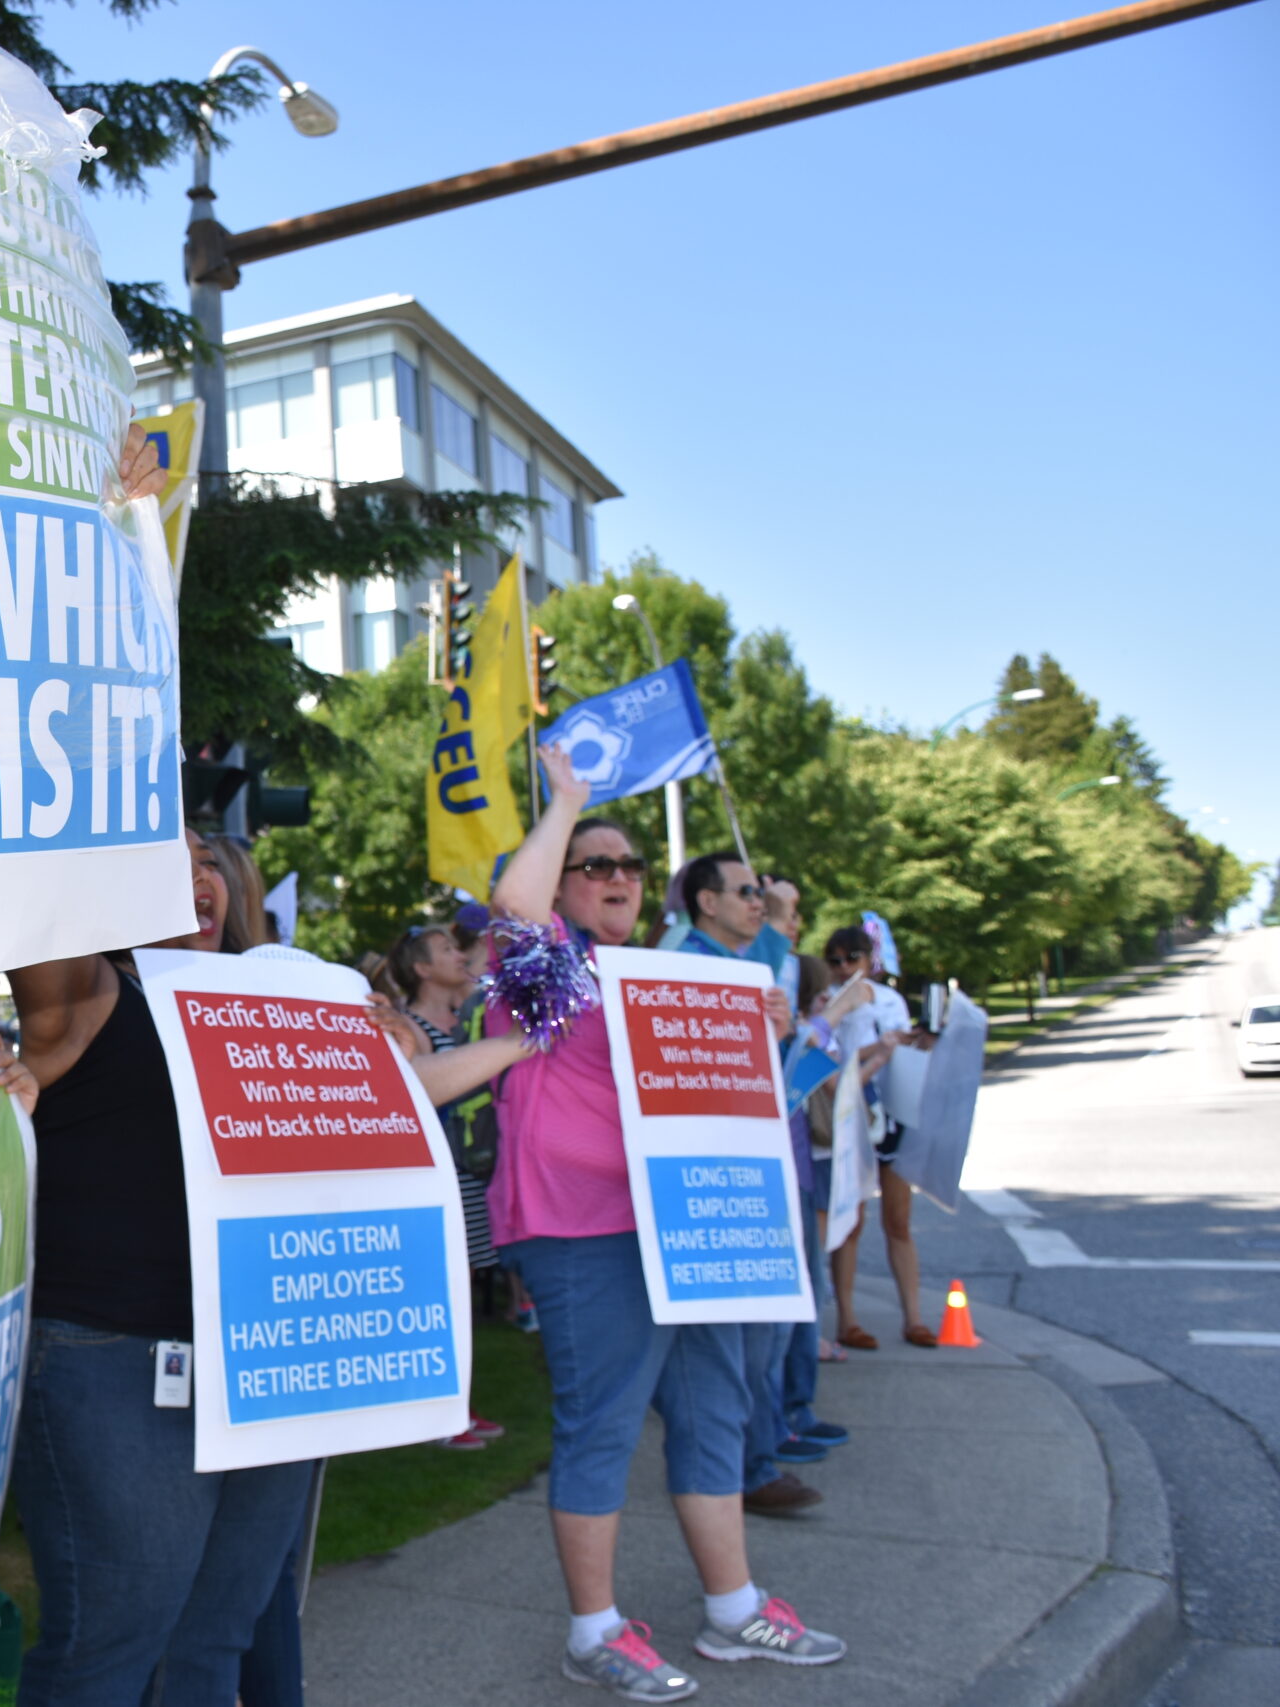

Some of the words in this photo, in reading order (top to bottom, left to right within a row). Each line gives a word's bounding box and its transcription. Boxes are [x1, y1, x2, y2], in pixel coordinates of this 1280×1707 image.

[8, 418, 103, 496] SINKI
[91, 683, 163, 834] IT?
[626, 984, 683, 1007] Pacific
[683, 986, 720, 1009] Blue
[185, 999, 264, 1028] Pacific
[263, 1003, 316, 1031] Blue
[315, 1007, 378, 1039] Cross,
[651, 1016, 687, 1039] Bait
[688, 1017, 702, 1040] &
[702, 1018, 752, 1042] Switch
[225, 1041, 275, 1070] Bait
[275, 1042, 297, 1070] &
[296, 1043, 371, 1071] Switch
[660, 1046, 691, 1064] Win
[691, 1047, 714, 1065] the
[240, 1080, 282, 1103] Win
[283, 1079, 316, 1102] the
[319, 1080, 378, 1104] award,
[638, 1071, 676, 1090] Claw
[675, 1070, 709, 1090] back
[709, 1071, 732, 1091] the
[213, 1115, 263, 1139] Claw
[264, 1113, 314, 1137] back
[314, 1113, 346, 1136] the
[346, 1111, 420, 1136] benefits
[682, 1166, 728, 1188] LONG
[727, 1165, 765, 1188] TERM
[686, 1197, 770, 1219] EMPLOYEES
[269, 1228, 336, 1260] LONG
[337, 1224, 401, 1254] TERM
[661, 1228, 709, 1251] HAVE
[708, 1227, 766, 1250] EARNED
[272, 1266, 404, 1303] EMPLOYEES
[229, 1318, 295, 1352] HAVE
[300, 1309, 393, 1345] EARNED
[397, 1303, 447, 1335] OUR
[238, 1362, 331, 1399] RETIREE
[336, 1346, 446, 1388] BENEFITS
